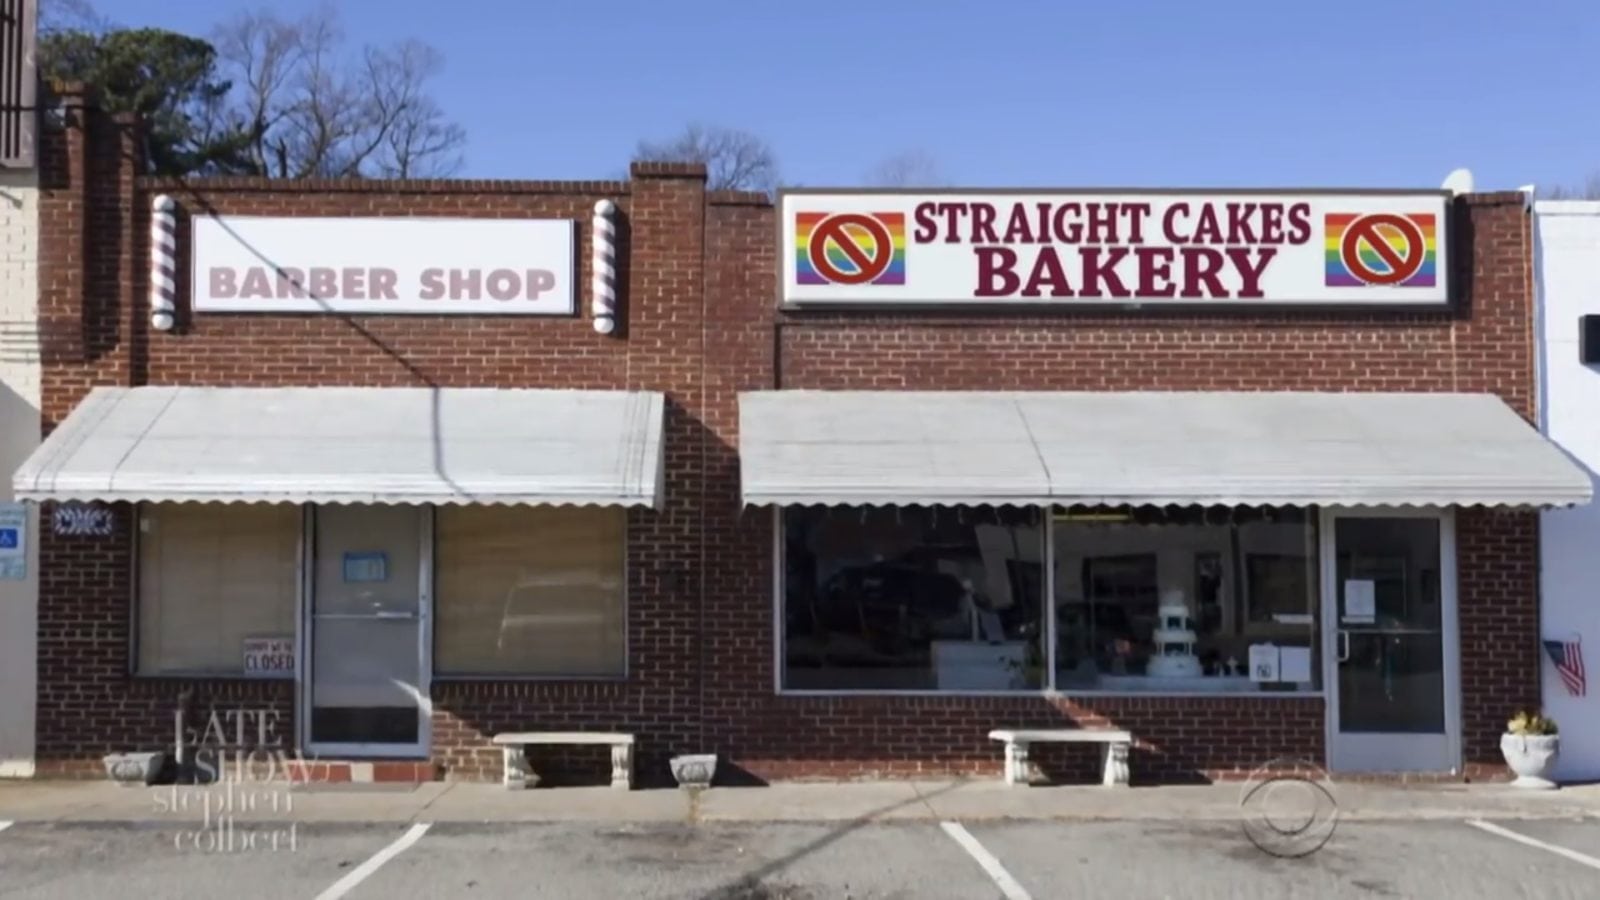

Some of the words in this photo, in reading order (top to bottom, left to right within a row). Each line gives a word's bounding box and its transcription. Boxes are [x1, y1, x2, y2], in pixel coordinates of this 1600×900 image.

[914, 202, 1151, 244] STRAIGHT
[1162, 202, 1312, 245] CAKES
[209, 266, 398, 300] BARBER
[418, 267, 556, 302] SHOP
[973, 246, 1277, 298] BAKERY
[245, 653, 295, 671] CLOSED
